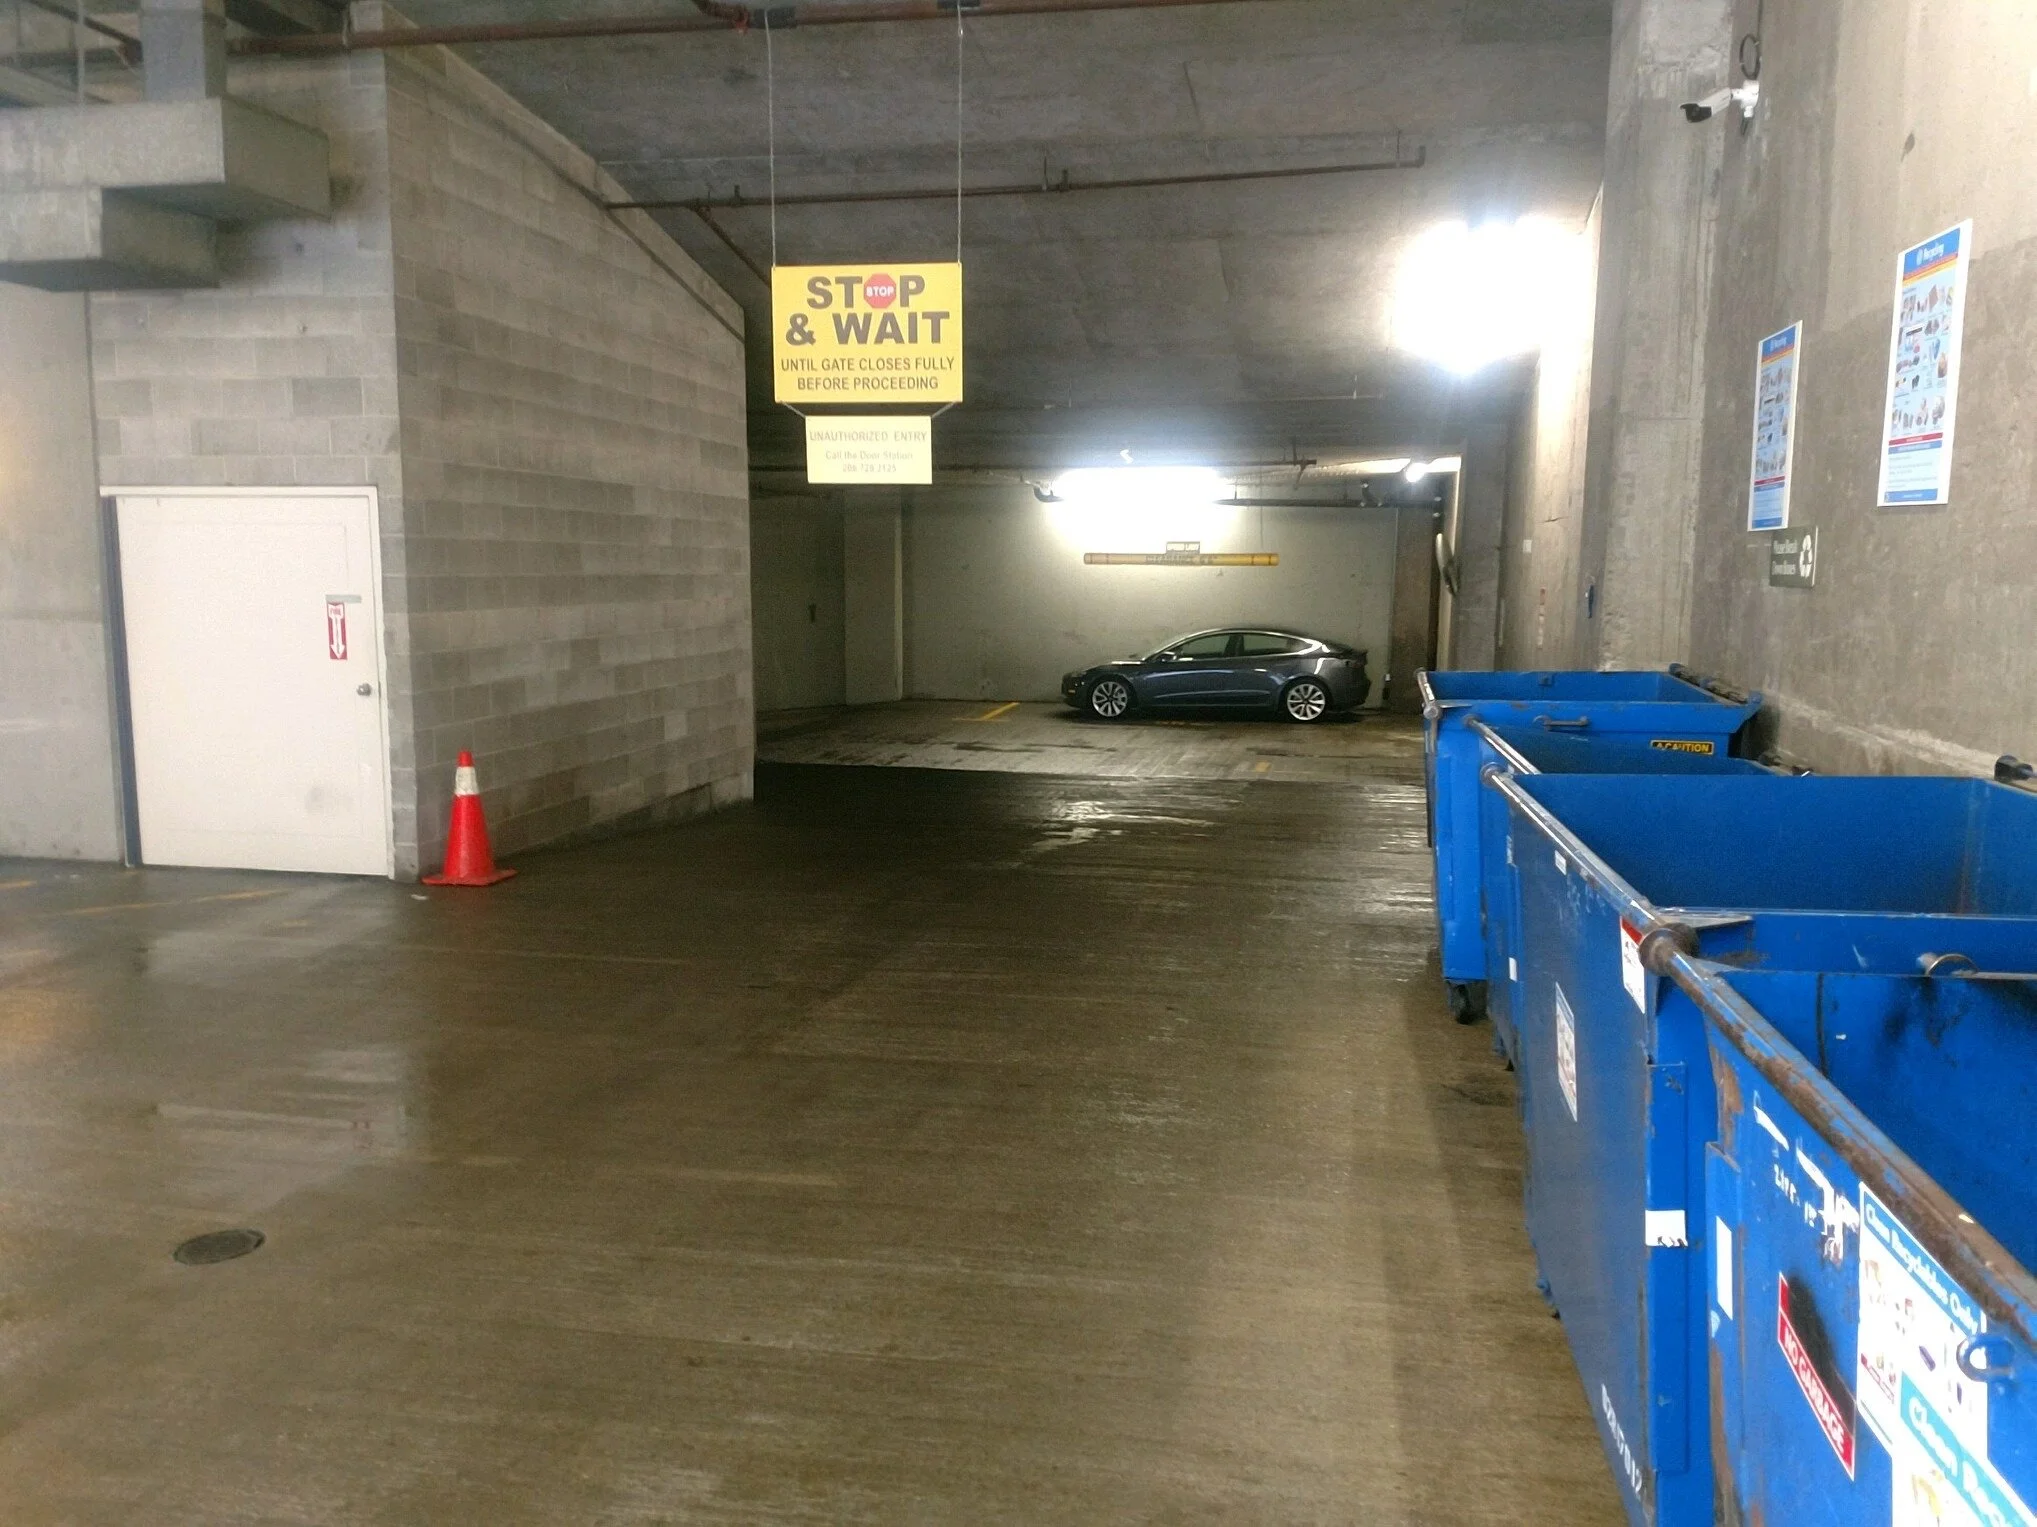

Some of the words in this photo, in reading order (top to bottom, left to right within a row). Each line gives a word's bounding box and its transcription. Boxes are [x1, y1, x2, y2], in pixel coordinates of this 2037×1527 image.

[866, 284, 894, 297] STOP
[785, 313, 816, 346] &
[832, 311, 950, 344] WAIT
[781, 358, 817, 371] UNTIL
[821, 358, 855, 371] GATE
[859, 357, 911, 371] CLOSES
[915, 356, 955, 370] FULLY
[797, 377, 849, 390] BEFORE
[853, 376, 939, 390] PROCEEDING
[809, 431, 888, 441] UNAUTHORIZED
[894, 431, 927, 441] ENTRY
[825, 451, 842, 460] Call
[844, 451, 857, 460] the
[860, 451, 880, 460] Door
[883, 451, 913, 460] Station
[1784, 1325, 1799, 1367] NO
